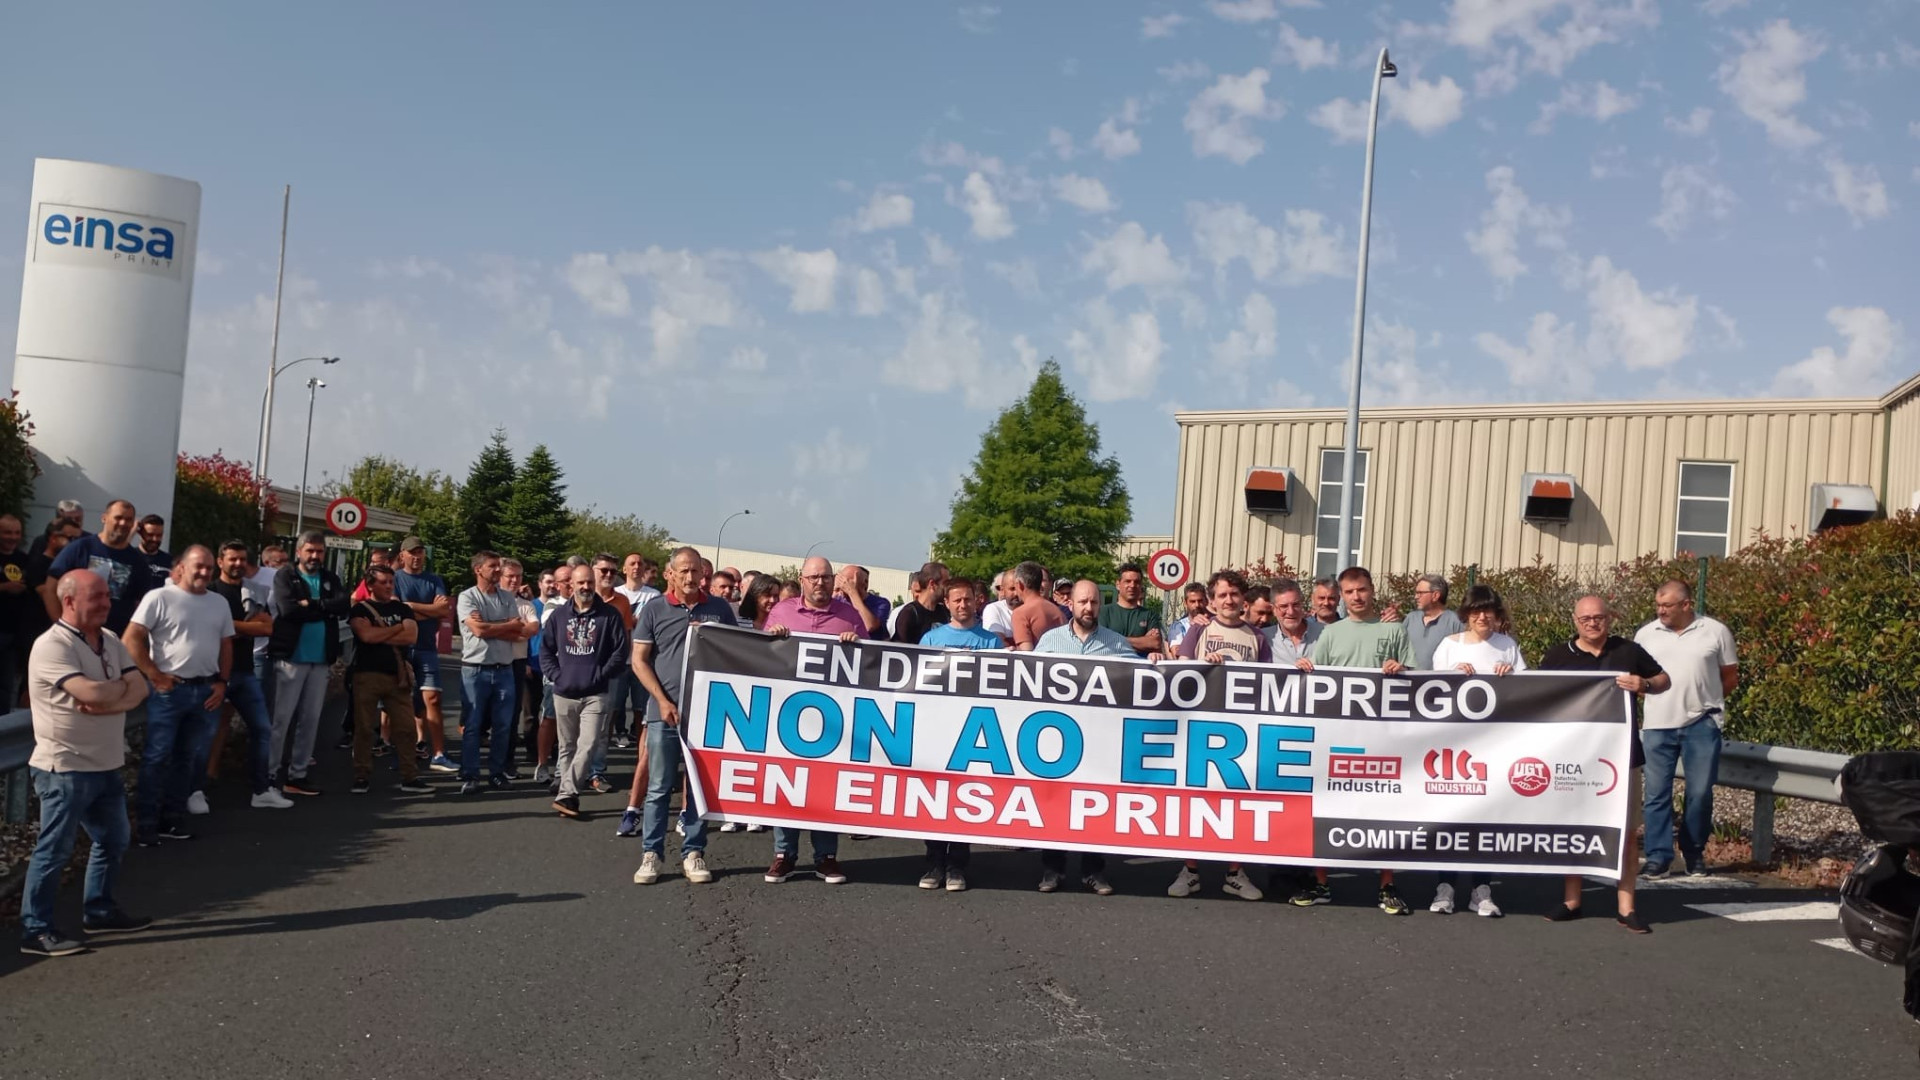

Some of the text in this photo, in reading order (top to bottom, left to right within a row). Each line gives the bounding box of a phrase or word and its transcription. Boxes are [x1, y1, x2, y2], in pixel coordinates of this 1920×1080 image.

[44, 213, 174, 260] einsa
[114, 253, 172, 268] PRINT
[336, 509, 356, 524] 10
[1159, 562, 1179, 577] 10
[795, 641, 1497, 721] EN DEFENSA DO EMPREGO
[703, 680, 1315, 792] NON AO ERE
[1333, 759, 1397, 774] CCOO
[1423, 748, 1487, 781] CIG
[1514, 762, 1546, 777] UGT
[1555, 763, 1583, 775] FICA
[1327, 778, 1402, 793] industria
[1427, 781, 1484, 794] INDUSTRIA
[718, 759, 1285, 842] EN EINSA PRINT
[1328, 827, 1606, 856] COMITÉ DE EMPRESA
